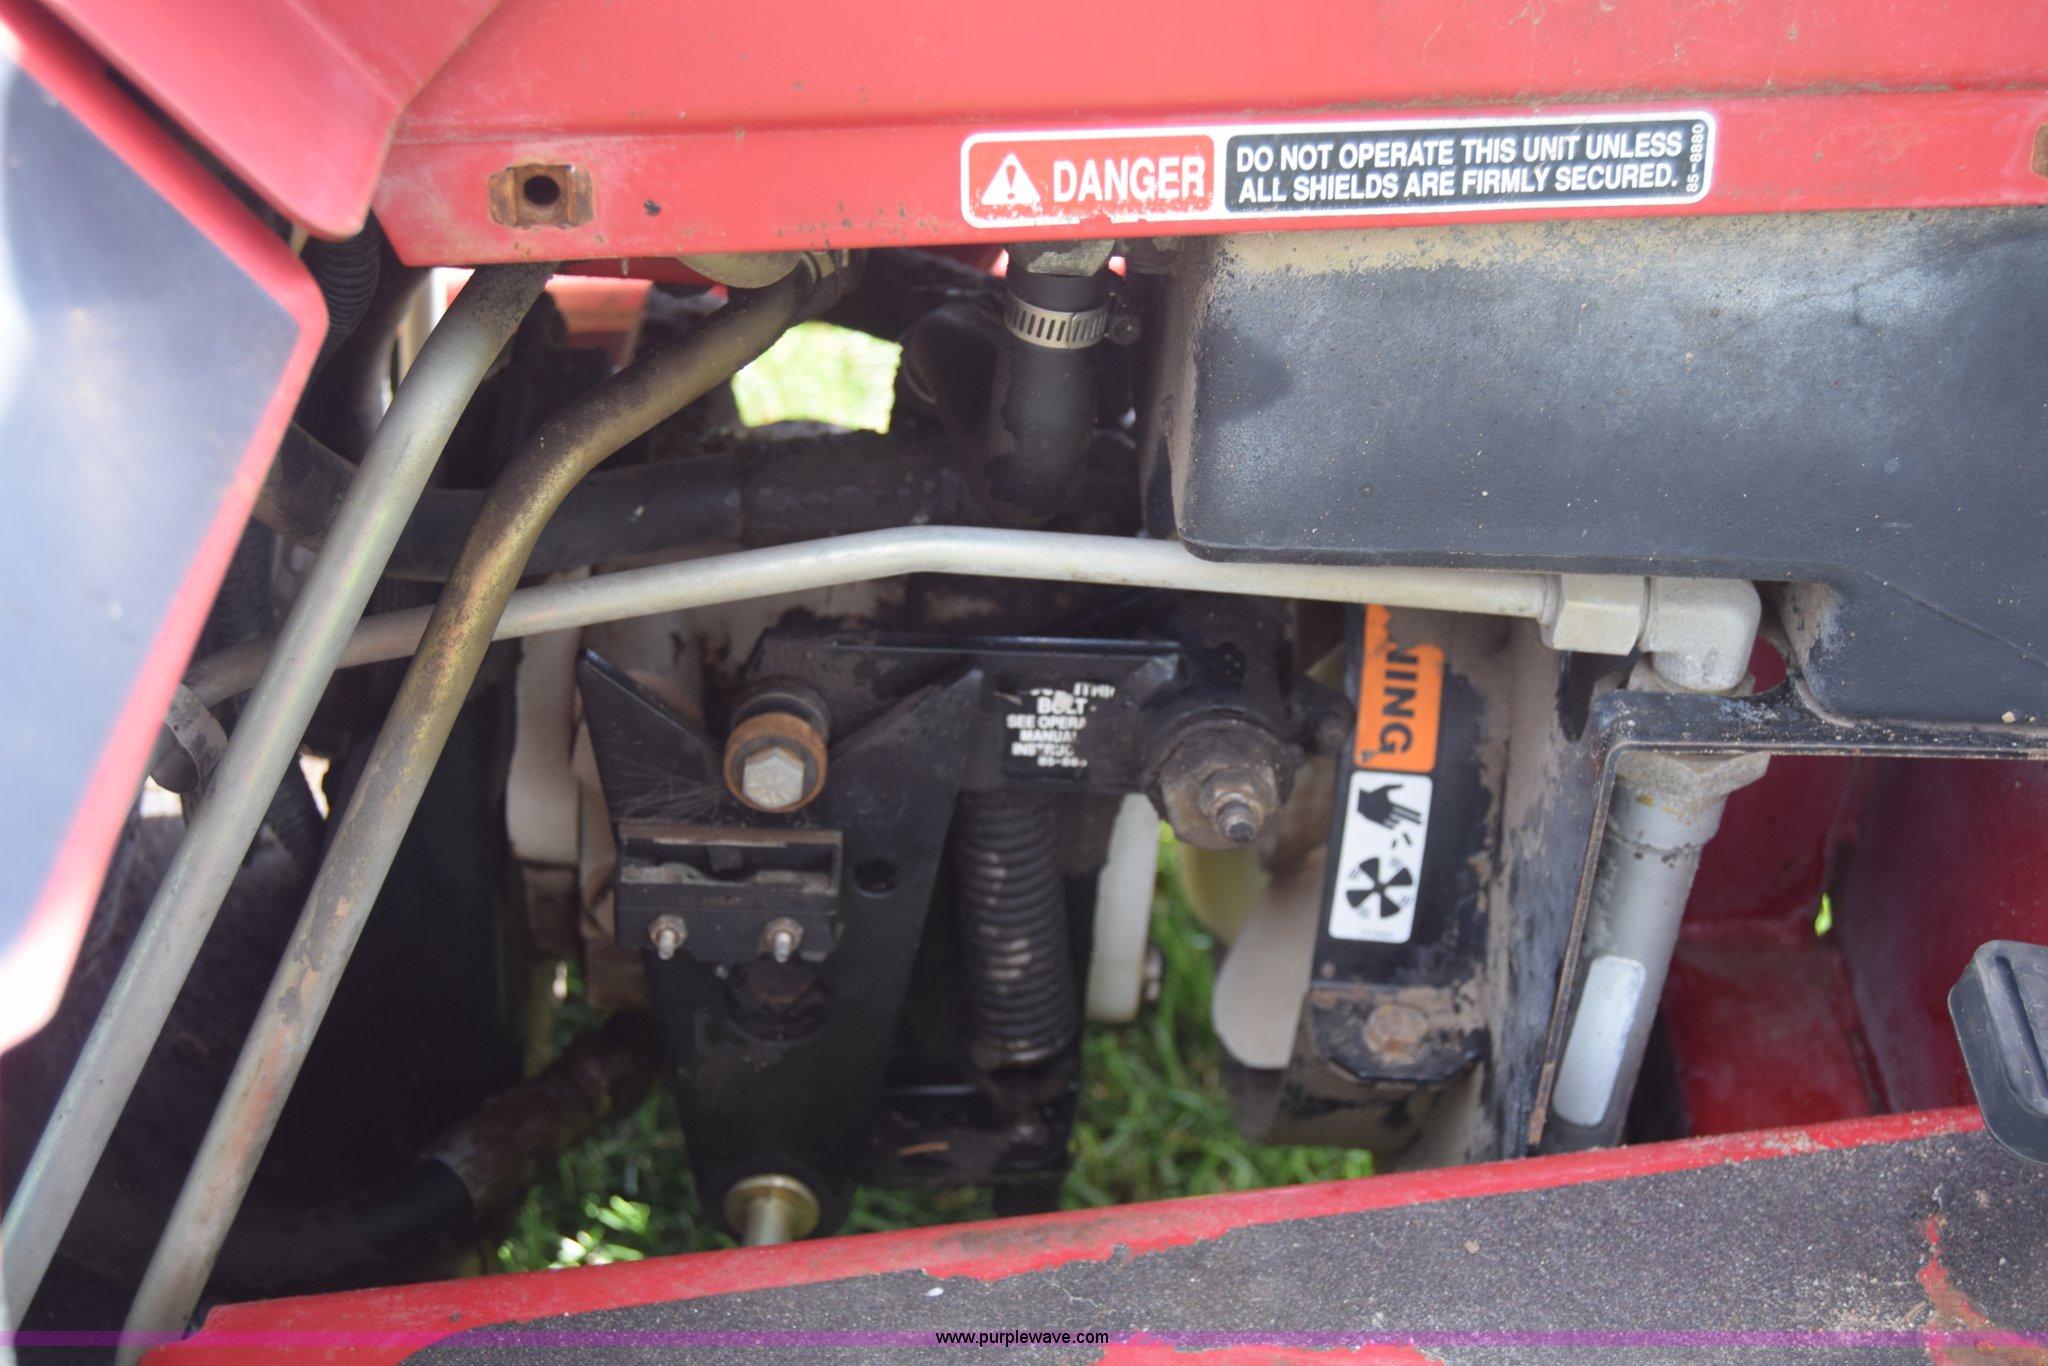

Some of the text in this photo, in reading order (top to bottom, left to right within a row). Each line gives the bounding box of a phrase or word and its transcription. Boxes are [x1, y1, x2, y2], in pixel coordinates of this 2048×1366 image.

[1236, 131, 1682, 173] DO NOT OPERATE THIS UNIT UNLESS
[1686, 123, 1705, 193] 85-8880
[1053, 156, 1206, 203] DANGER
[1238, 161, 1678, 204] ALL SHIELDS ARE FIRMLY SECURED.
